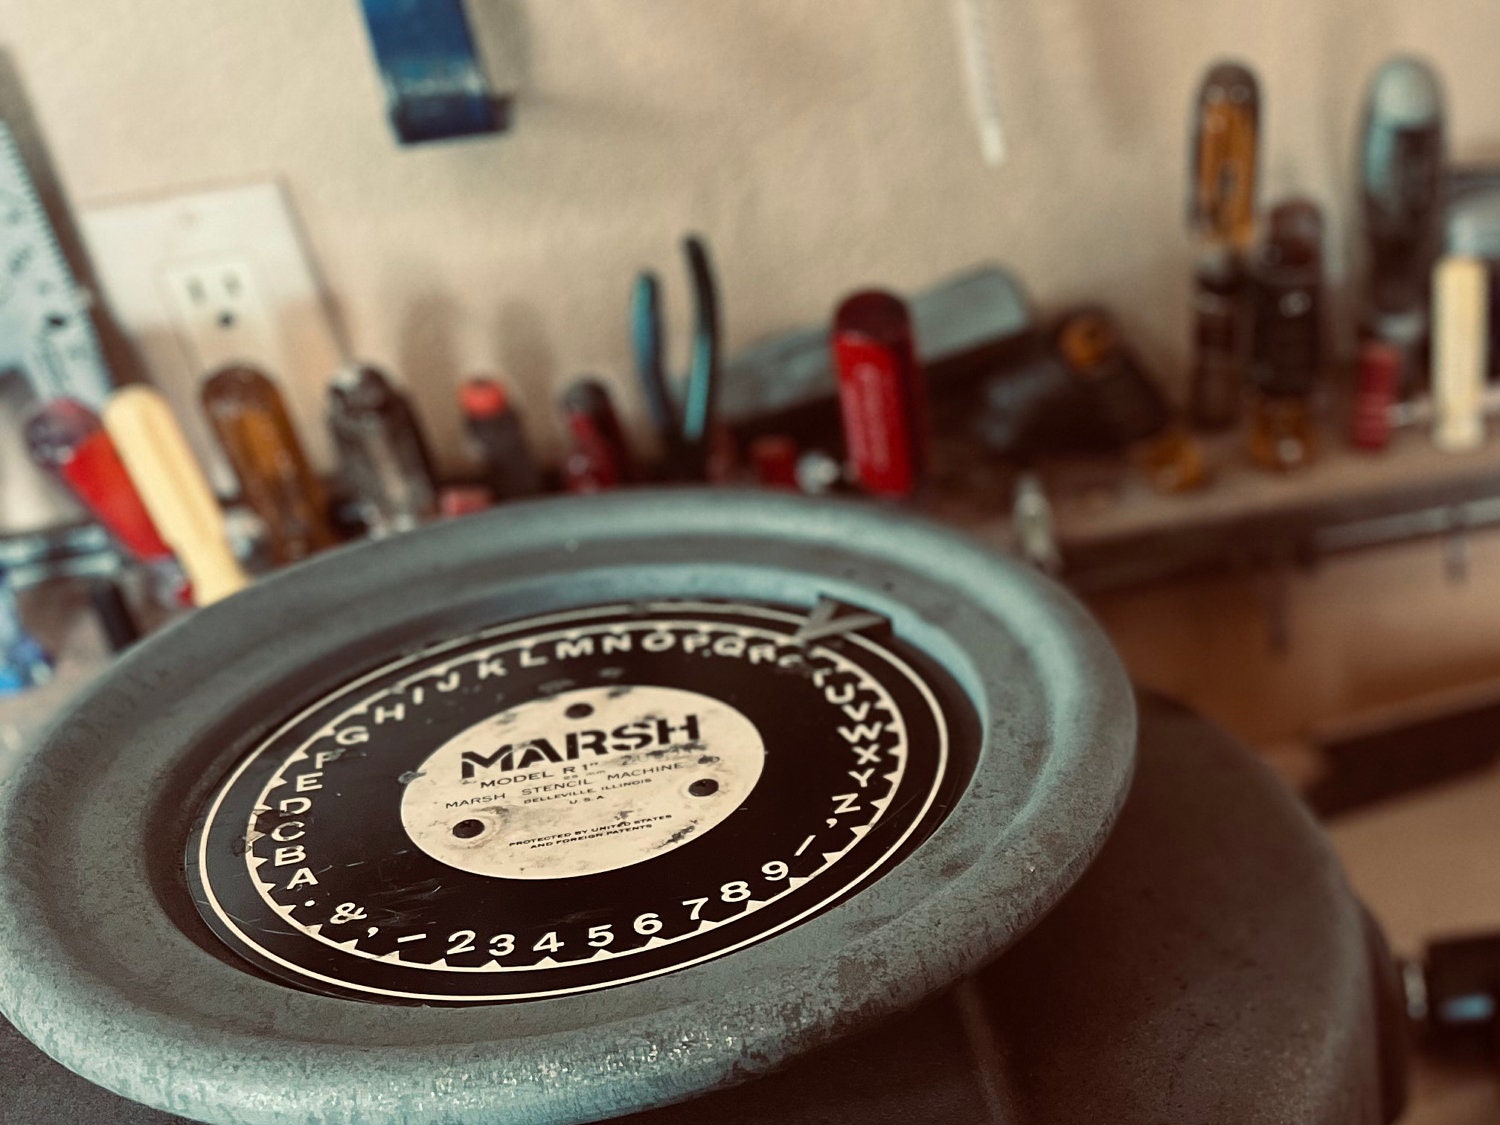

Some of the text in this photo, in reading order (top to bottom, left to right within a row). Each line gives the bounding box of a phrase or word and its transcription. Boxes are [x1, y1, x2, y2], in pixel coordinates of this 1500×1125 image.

[556, 640, 594, 660] M
[602, 636, 632, 654] N
[642, 632, 676, 652] O
[520, 650, 548, 668] L
[478, 660, 507, 680] K
[436, 672, 460, 692] J
[825, 683, 855, 704] U
[374, 703, 404, 724] H
[842, 701, 870, 722] V
[336, 726, 370, 745] G
[837, 722, 882, 742] W
[461, 714, 701, 780] MARSH
[852, 744, 882, 764] X
[296, 772, 324, 792] E
[445, 761, 685, 810] MARSH STENCIL MACHINE
[480, 770, 554, 789] MODEL
[848, 768, 875, 788] Y
[523, 778, 653, 804] BELLEVILLE ILLINOIS
[279, 796, 312, 817] D
[832, 793, 860, 814] Z
[271, 821, 306, 842] C
[509, 814, 673, 847] PROTECTED BY UNITED STATES
[530, 824, 654, 850] AND FOREIGN PATENTS
[274, 845, 306, 866] B
[286, 868, 318, 890] A
[445, 930, 477, 955] 2
[488, 934, 516, 957] 3
[532, 931, 566, 954] 4
[587, 924, 616, 948] 5
[632, 912, 664, 936] 6
[682, 897, 710, 920] 7
[719, 880, 752, 904] 8
[760, 860, 790, 882] 9
